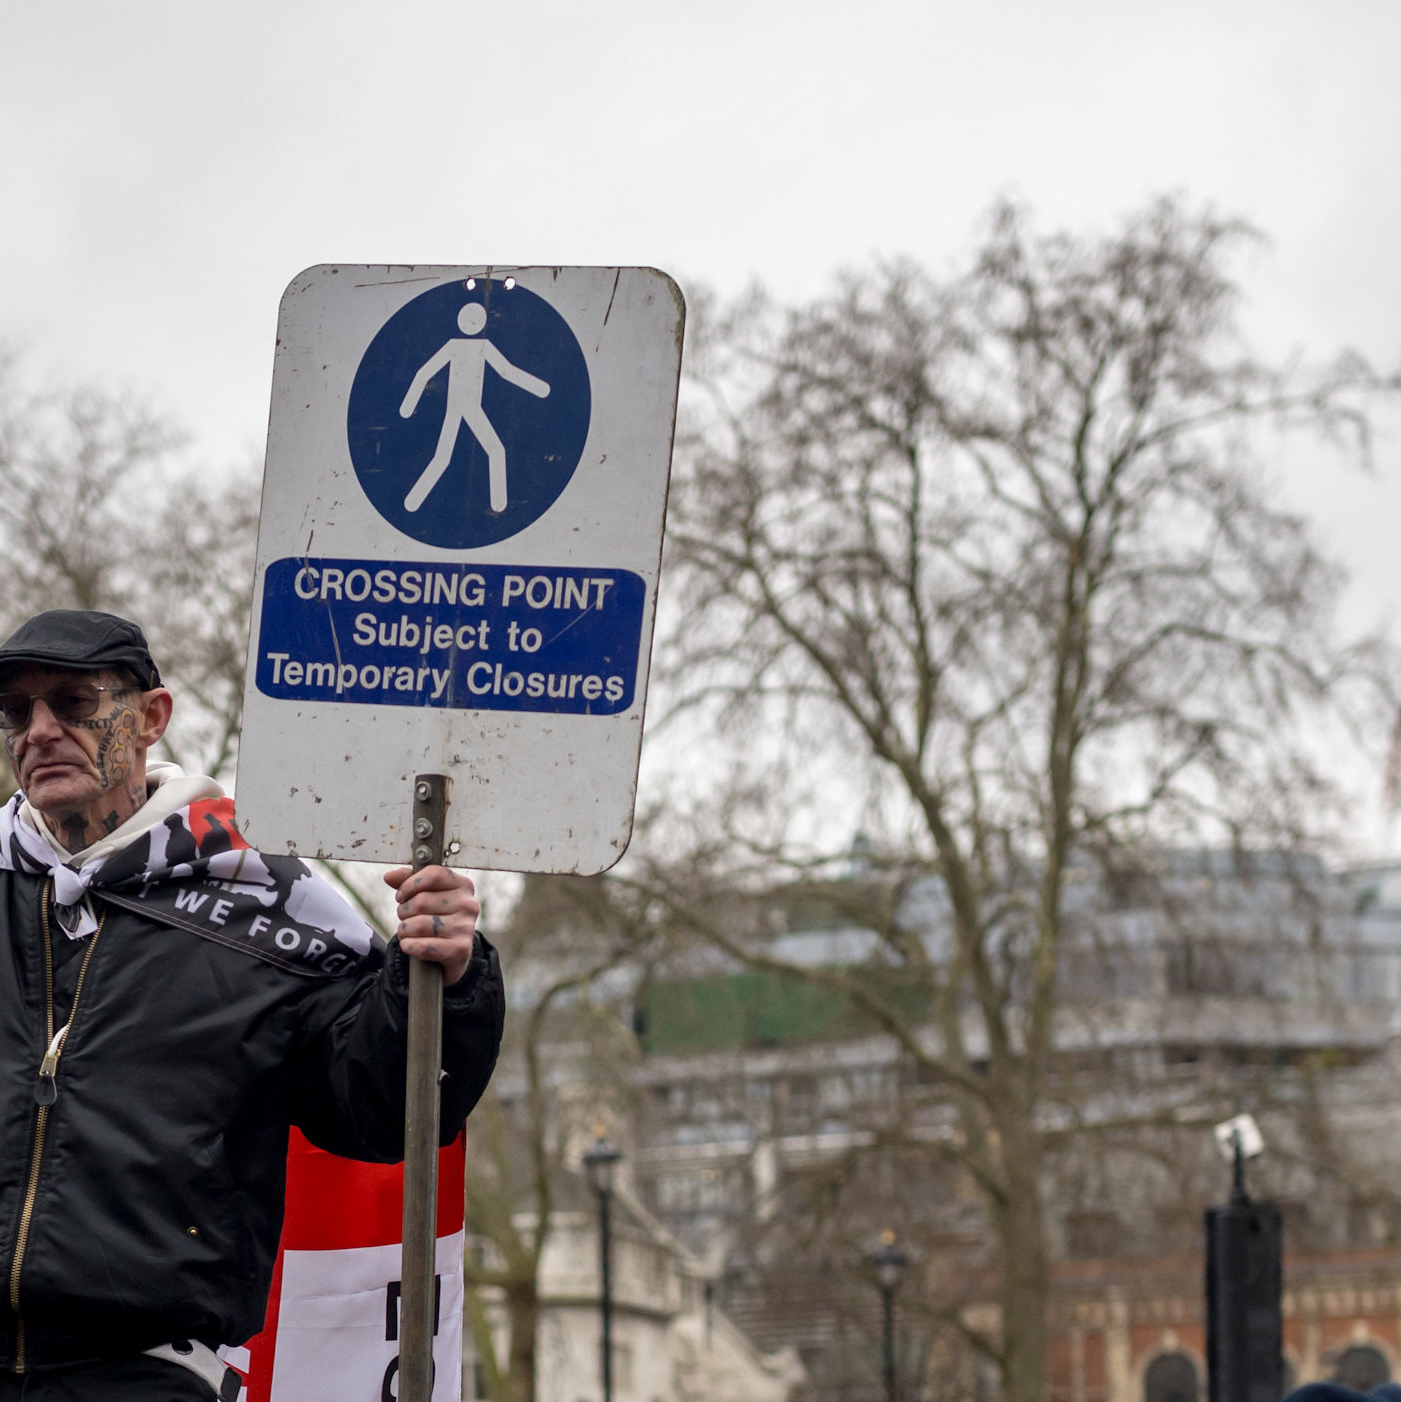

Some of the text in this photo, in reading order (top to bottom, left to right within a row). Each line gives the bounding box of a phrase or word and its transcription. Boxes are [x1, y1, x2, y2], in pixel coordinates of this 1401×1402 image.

[294, 566, 614, 610] CROSSING POINT
[352, 612, 543, 656] Subject to
[266, 652, 624, 701] Temporary Closures
[174, 888, 357, 974] WE FORG
